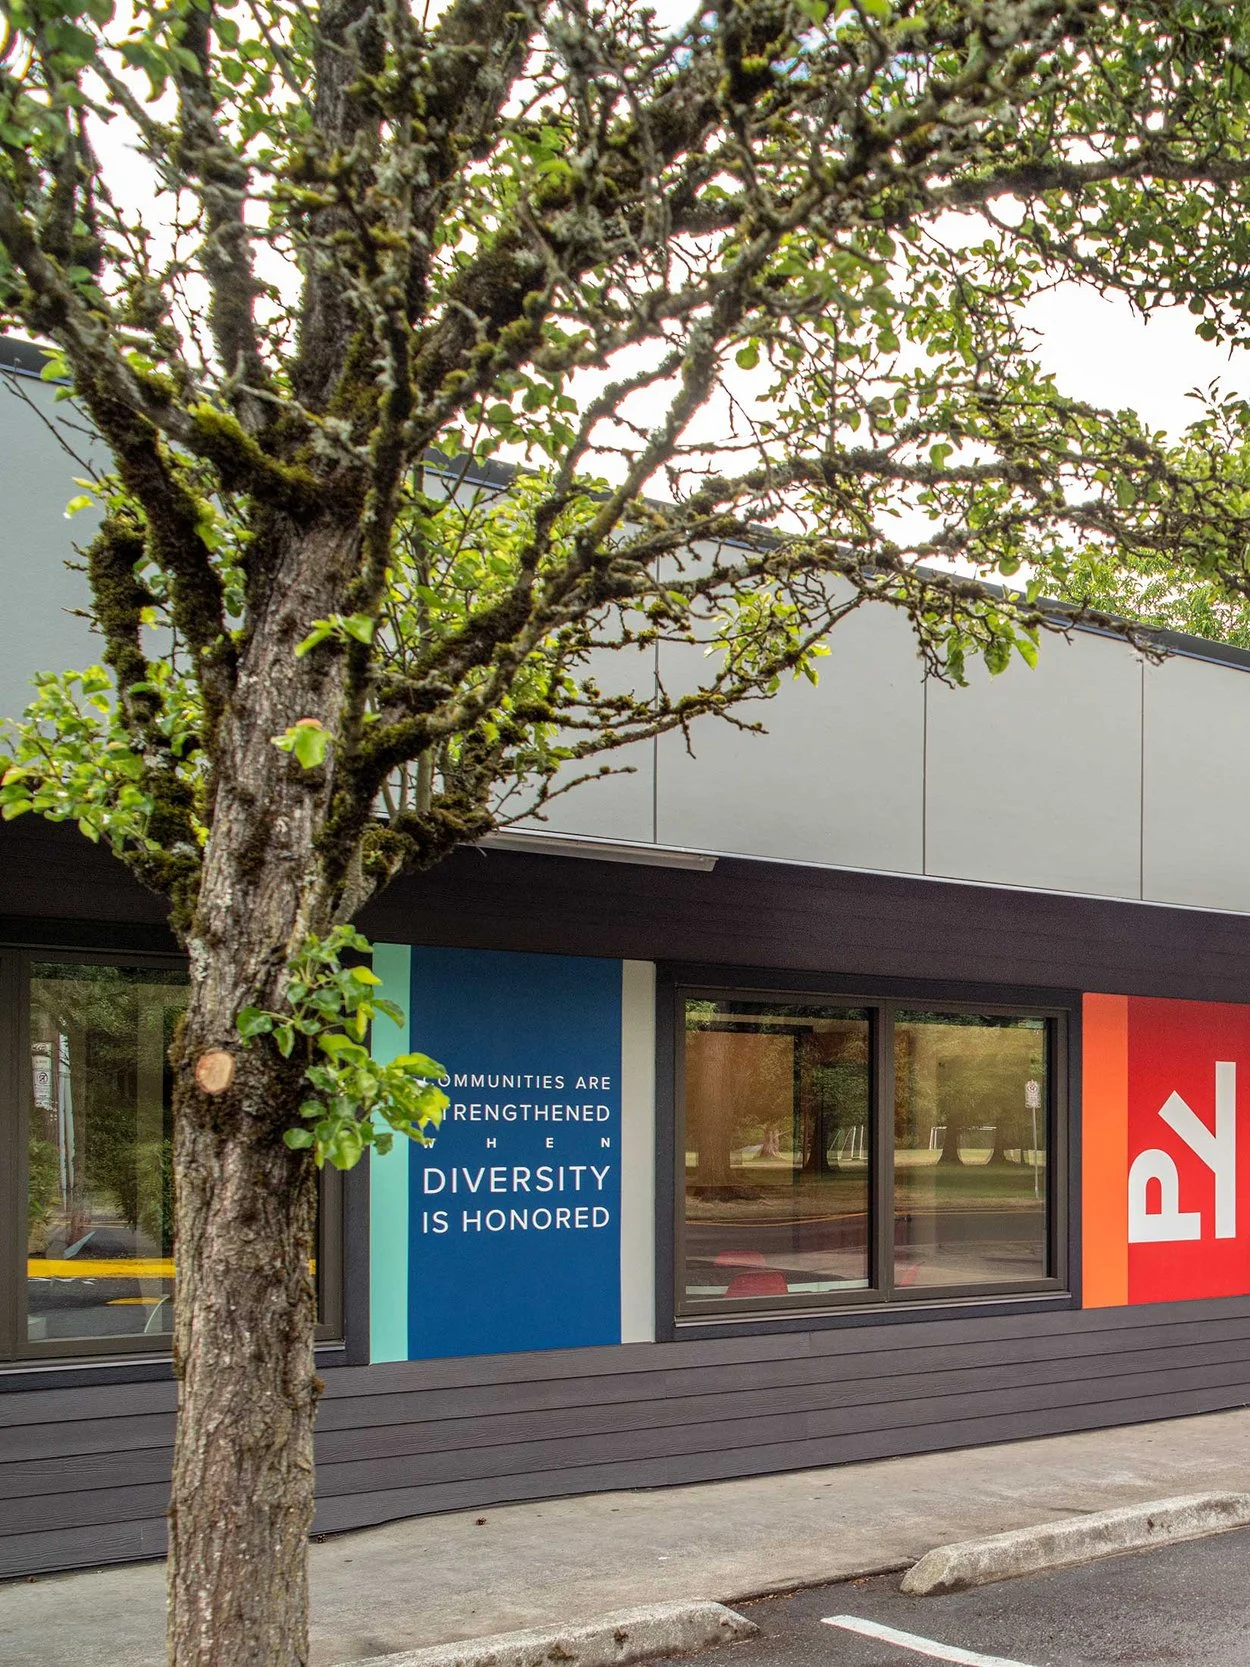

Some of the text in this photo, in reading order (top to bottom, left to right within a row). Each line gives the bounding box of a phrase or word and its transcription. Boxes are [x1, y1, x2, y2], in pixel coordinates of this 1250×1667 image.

[575, 1076, 611, 1090] ARE
[427, 1103, 610, 1122] TRENGTHENED
[423, 1165, 611, 1195] DIVERSITY
[423, 1206, 610, 1234] IS HONORED
